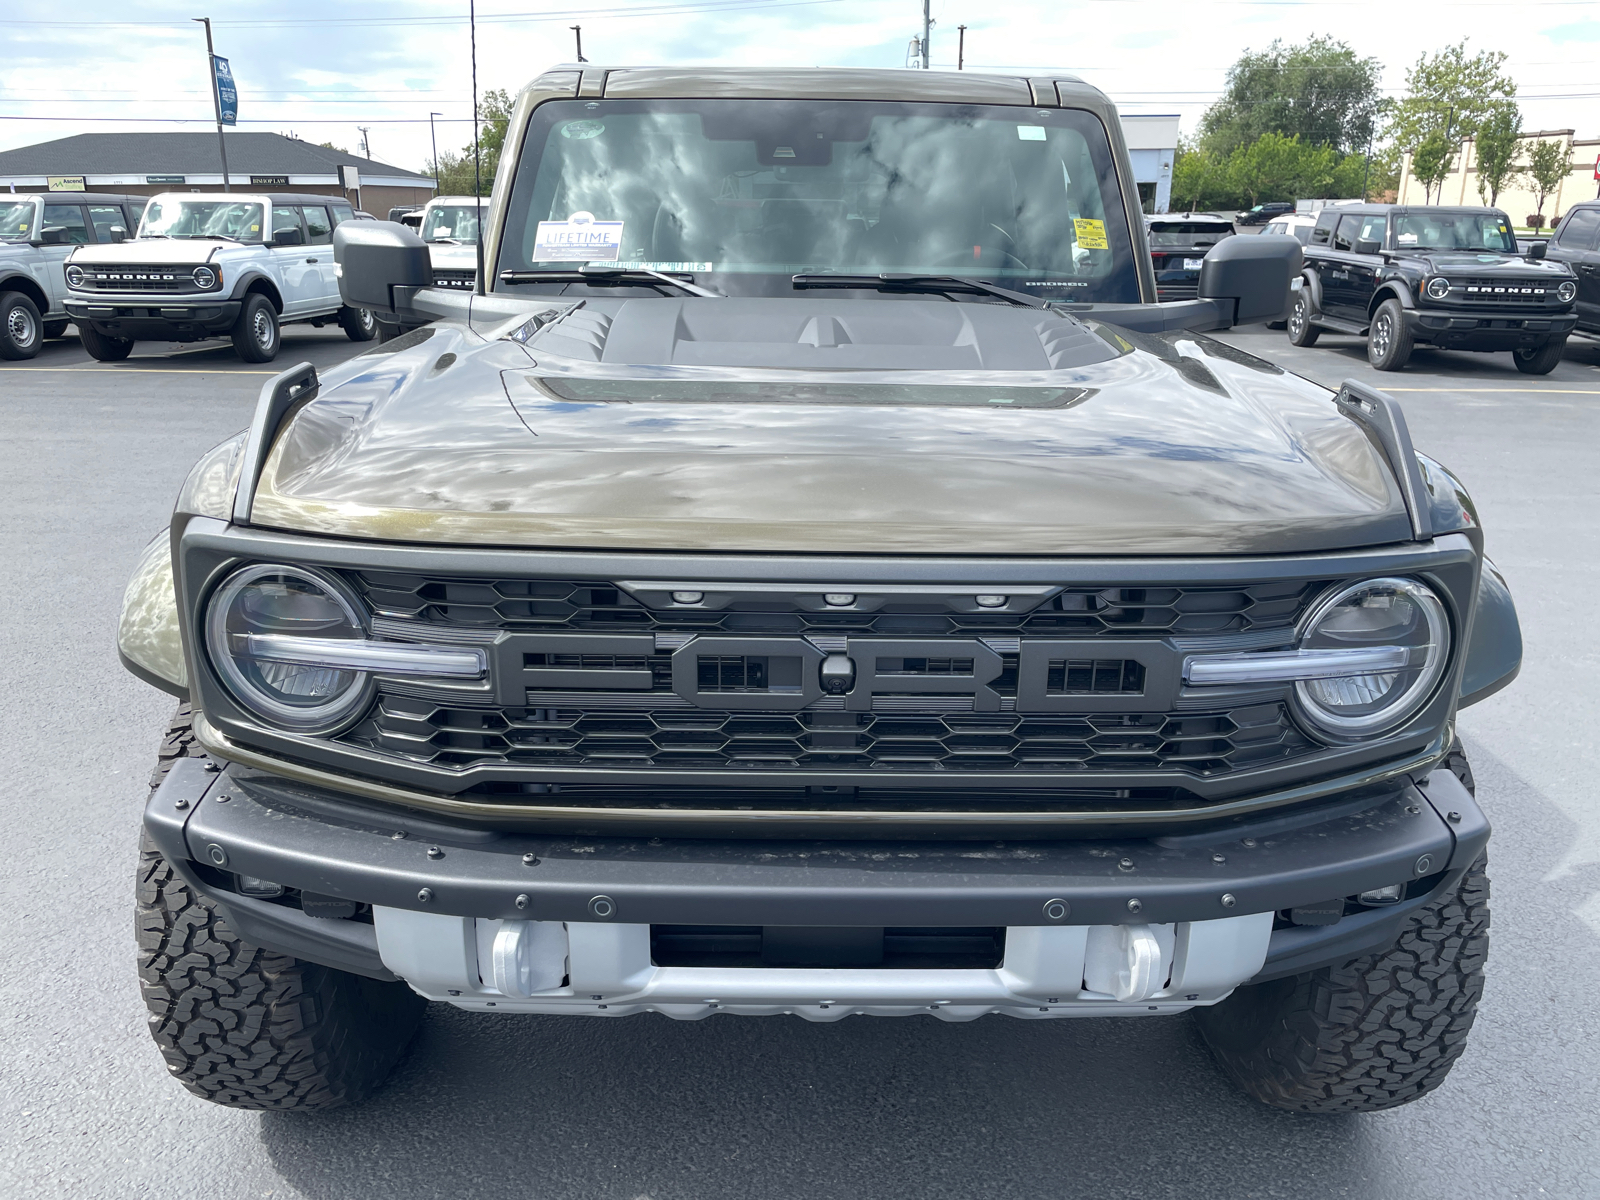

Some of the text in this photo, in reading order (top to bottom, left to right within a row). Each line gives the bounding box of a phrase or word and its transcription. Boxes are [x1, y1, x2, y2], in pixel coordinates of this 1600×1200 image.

[546, 232, 611, 243] LIFETIME
[1467, 286, 1545, 294] BRONCO
[494, 632, 1176, 711] FORD
